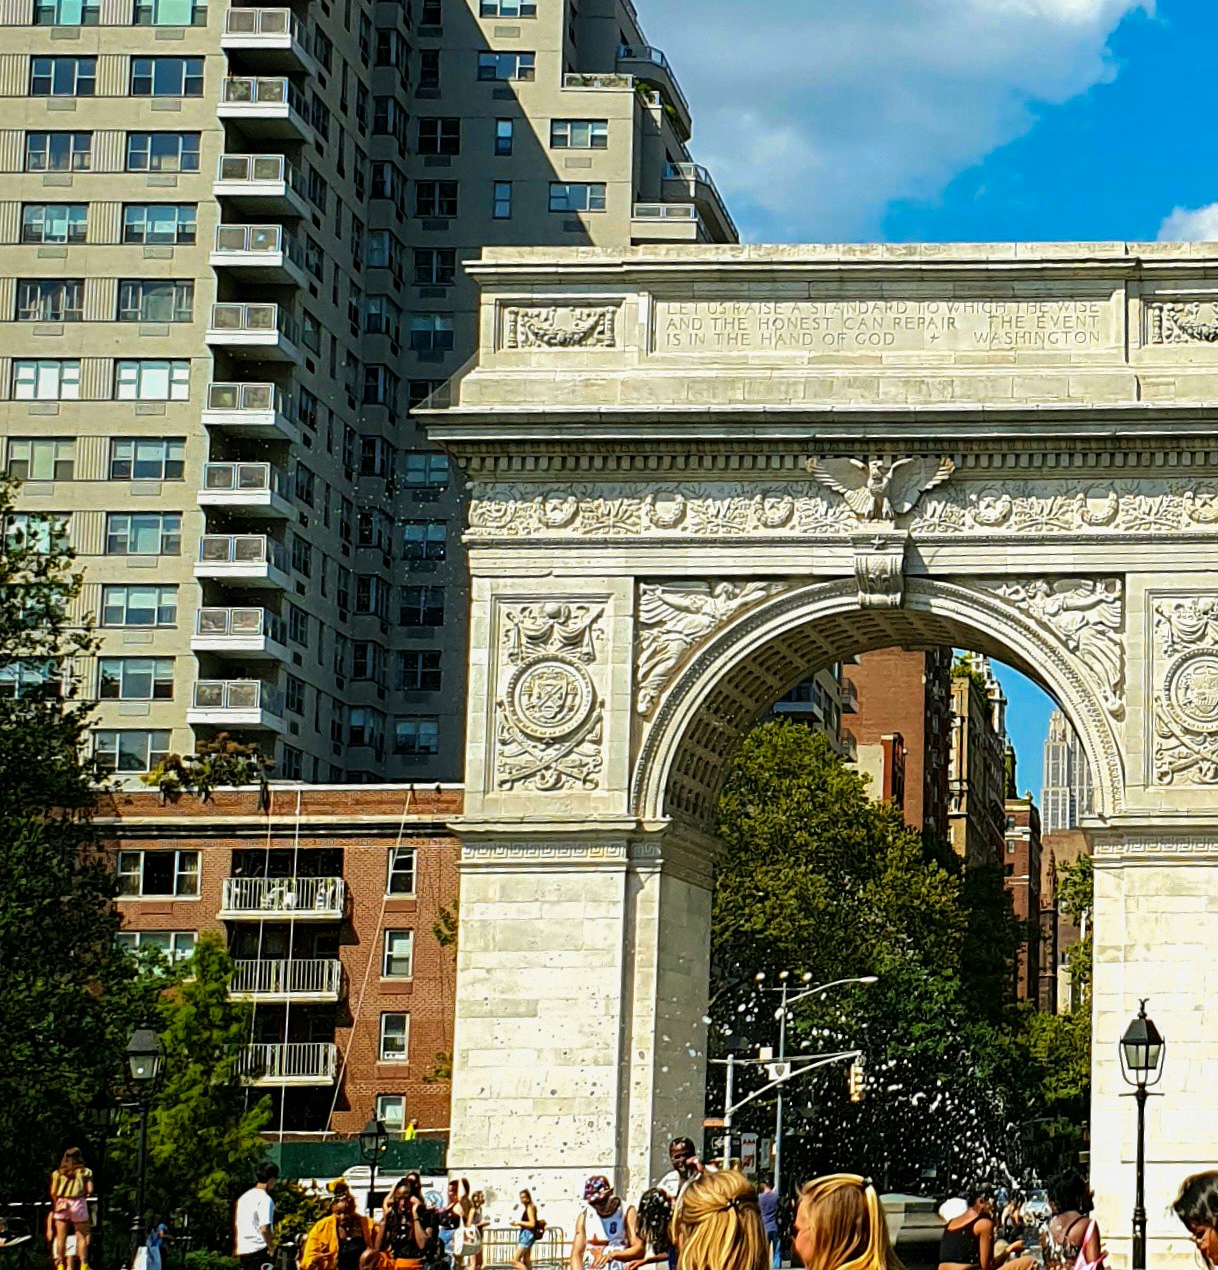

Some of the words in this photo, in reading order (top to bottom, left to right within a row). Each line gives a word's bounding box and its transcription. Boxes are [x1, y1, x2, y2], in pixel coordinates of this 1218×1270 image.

[667, 302, 698, 315] LET
[708, 302, 726, 315] US
[733, 302, 784, 315] RAISE
[791, 302, 801, 315] A
[811, 302, 907, 315] STANDARD
[918, 302, 939, 314] TO
[947, 302, 1006, 314] WHICH
[1016, 301, 1048, 314] THE
[1057, 301, 1100, 314] WISE
[667, 317, 702, 330] AND
[711, 317, 748, 330] THE
[758, 317, 833, 330] HONEST
[844, 317, 883, 330] CAN
[893, 316, 957, 329] REPAIR
[988, 315, 1025, 329] THE
[1037, 315, 1100, 329] EVENT
[667, 332, 681, 346] IS
[689, 332, 705, 346] IN
[714, 332, 750, 346] THE
[761, 332, 813, 346] HAND
[823, 332, 846, 345] OF
[855, 331, 895, 345] GOD
[974, 331, 1100, 345] WASHINGTON
